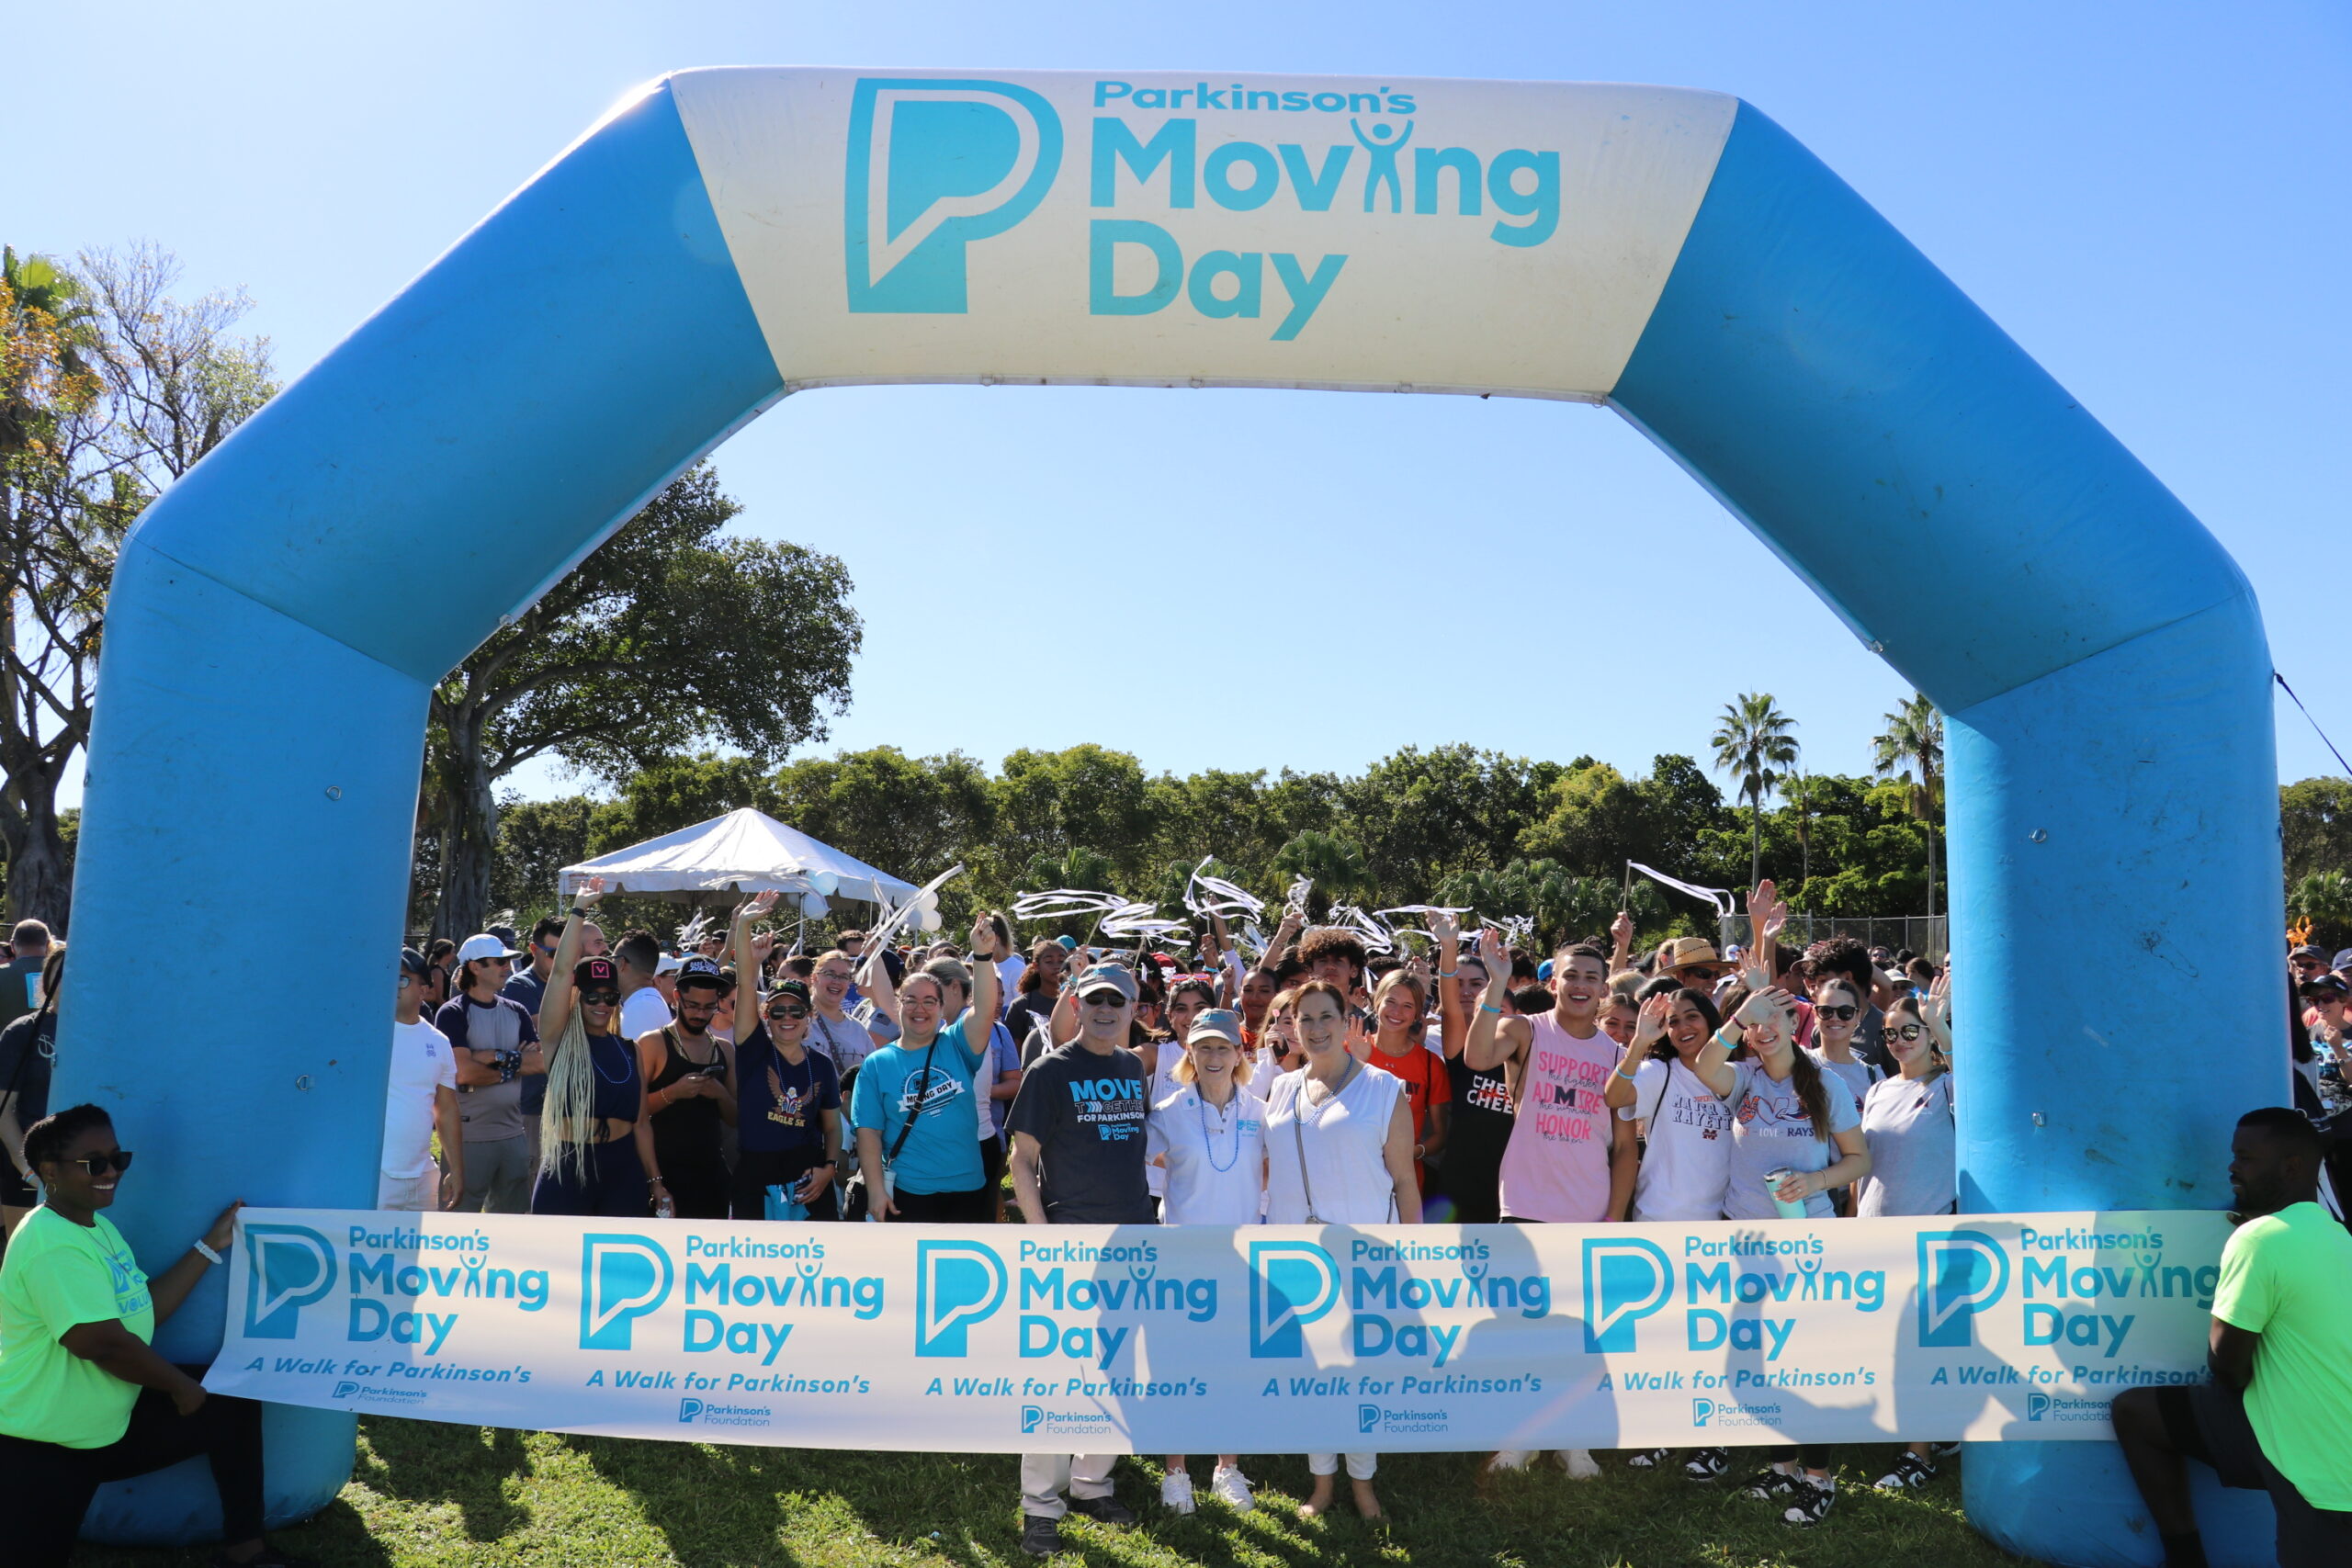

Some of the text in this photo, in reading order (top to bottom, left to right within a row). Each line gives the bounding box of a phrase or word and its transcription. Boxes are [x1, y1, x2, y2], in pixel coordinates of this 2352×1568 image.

[1094, 81, 1417, 114] Parkinson's
[1090, 117, 1560, 248] Moving
[1090, 219, 1349, 341] Day
[1538, 1051, 1610, 1086] SUPPORT
[907, 1081, 953, 1103] MONG DAY
[1069, 1078, 1143, 1102] MOVE
[1473, 1075, 1510, 1095] CHE
[1466, 1089, 1514, 1114] CHEE
[1532, 1081, 1604, 1114] ADMIRE
[767, 1111, 806, 1127] EAGLE 5K
[1077, 1111, 1145, 1122] FOR PARKINSON
[1536, 1112, 1591, 1140] HONOR
[1672, 1109, 1732, 1131] RAYETT
[1112, 1126, 1139, 1134] Moving
[1759, 1128, 1779, 1137] LOVE
[1787, 1128, 1815, 1137] RAYS
[349, 1226, 489, 1251] Parkinson's
[686, 1235, 824, 1259] Parkinson's
[1351, 1239, 1489, 1262] Parkinson's
[1685, 1234, 1823, 1257] Parkinson's
[2021, 1226, 2163, 1251] Foundatio
[1019, 1240, 1157, 1263] Parkinson's
[348, 1252, 548, 1311] Moving
[684, 1262, 884, 1319] Moving
[1354, 1262, 1550, 1318] Moving
[1687, 1257, 1885, 1313] Moving
[2022, 1251, 2220, 1310] Moving
[1019, 1264, 1217, 1322] Moving
[347, 1298, 458, 1355] Day
[684, 1310, 794, 1365] Day
[1688, 1308, 1795, 1361] Day
[2023, 1303, 2135, 1358] Day
[1019, 1314, 1128, 1370] Day
[1354, 1314, 1463, 1367] Day
[1692, 1310, 1714, 1397] P
[243, 1357, 531, 1382] A Walk for Parkinson's
[586, 1370, 869, 1393] A Walk for Parkinson's
[1598, 1367, 1875, 1392] A Walk for Parkinson's
[1931, 1365, 2213, 1385] A Walk for Parkinson's
[332, 1381, 359, 1398] P
[925, 1377, 1207, 1397] A Walk for Parkinson's
[1262, 1373, 1542, 1396] A Walk for Parkinson's
[358, 1394, 424, 1404] Foundation
[679, 1397, 704, 1423] P
[706, 1404, 772, 1416] Parkinson's
[1718, 1403, 1781, 1416] Parkinson's
[2053, 1399, 2113, 1409] Parkinson's
[705, 1415, 770, 1426] Foundation
[1046, 1410, 1111, 1423] Parkinson's
[1383, 1408, 1448, 1421] Parkinson's
[1718, 1415, 1781, 1427] Foundation
[2053, 1410, 2113, 1421] Foundation
[1045, 1423, 1111, 1434] Foundation
[1383, 1421, 1448, 1433] Foundation
